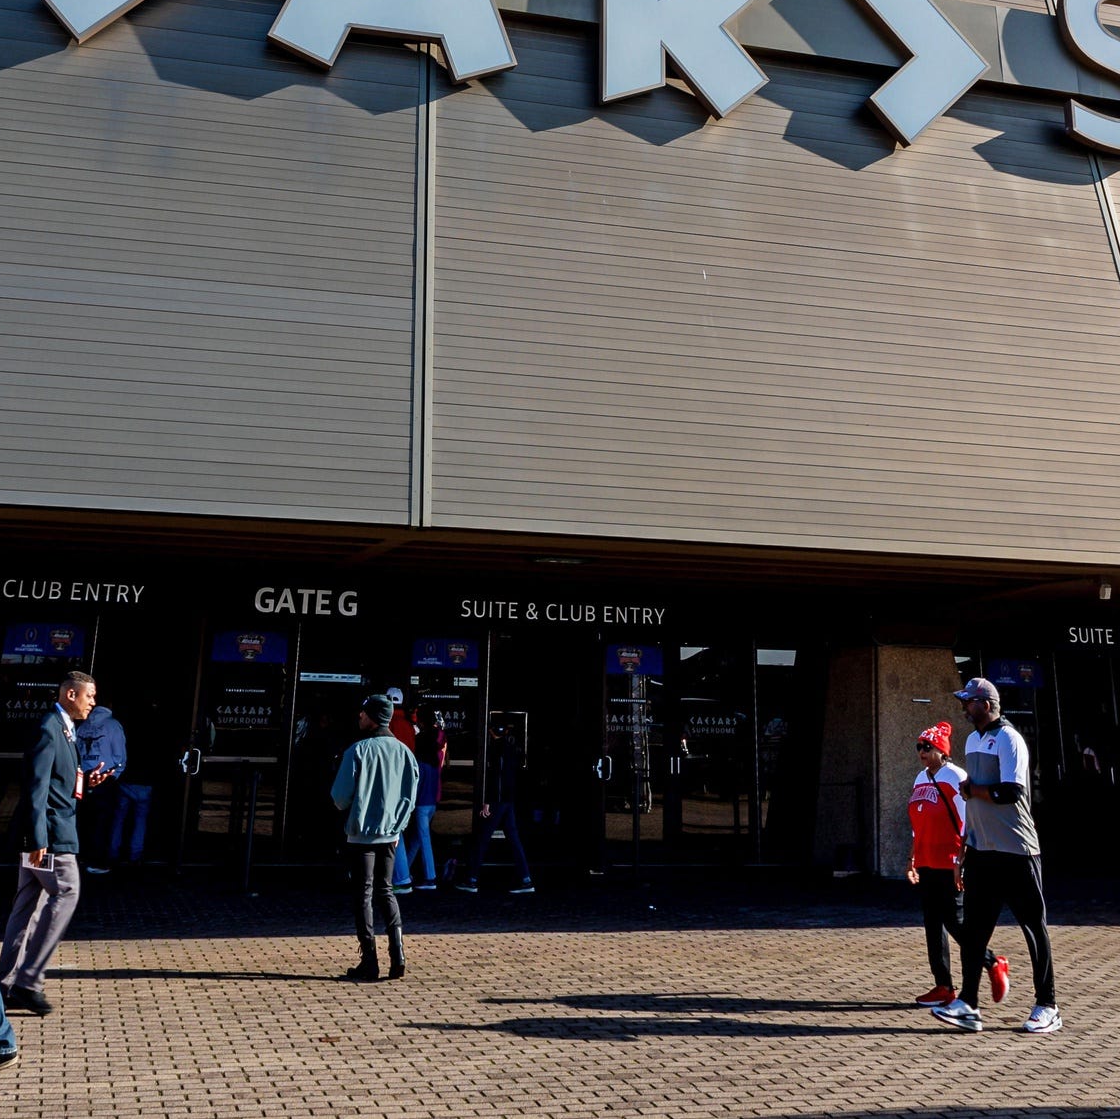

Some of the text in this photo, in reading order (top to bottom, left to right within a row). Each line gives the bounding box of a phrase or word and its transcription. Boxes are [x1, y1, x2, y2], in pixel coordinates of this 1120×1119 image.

[2, 579, 62, 600] CLUB
[70, 582, 145, 603] ENTRY
[254, 587, 358, 617] GATE G
[460, 599, 665, 625] SUITE & CLUB ENTRY
[1068, 626, 1115, 645] SUITE
[216, 705, 272, 716] CAESARS
[217, 716, 269, 725] SUPERDOME
